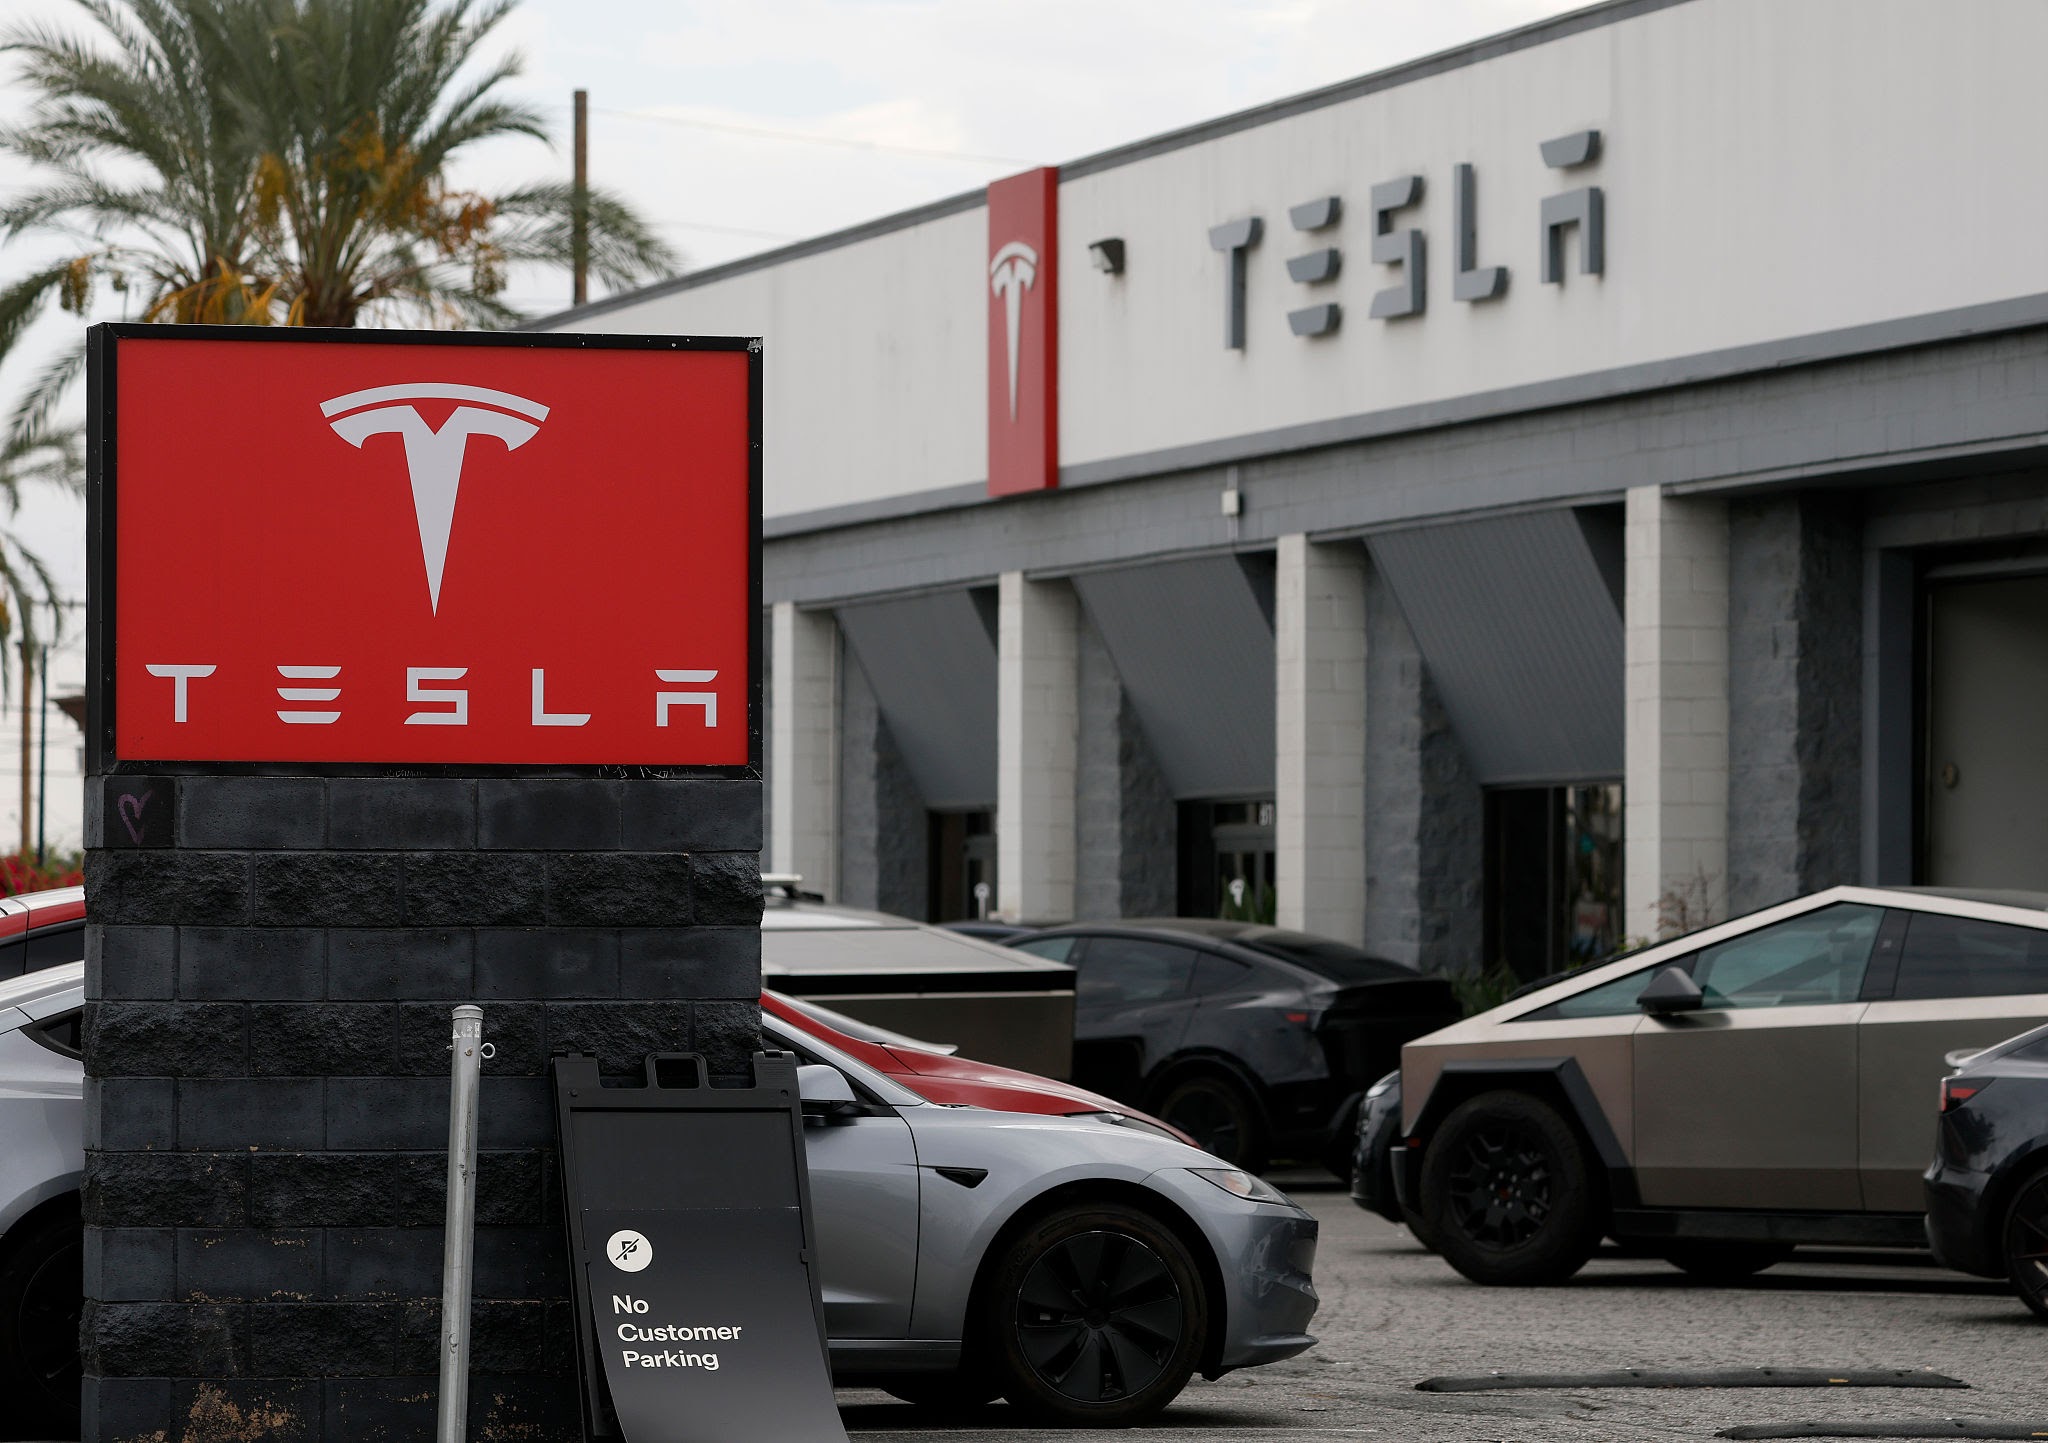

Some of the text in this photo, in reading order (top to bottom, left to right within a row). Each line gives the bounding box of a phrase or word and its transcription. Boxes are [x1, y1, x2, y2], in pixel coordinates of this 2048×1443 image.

[1208, 129, 1604, 349] TESLA
[145, 664, 718, 727] TESLA
[612, 1294, 650, 1315] No
[616, 1323, 743, 1342] Customer
[622, 1349, 720, 1371] Parking
